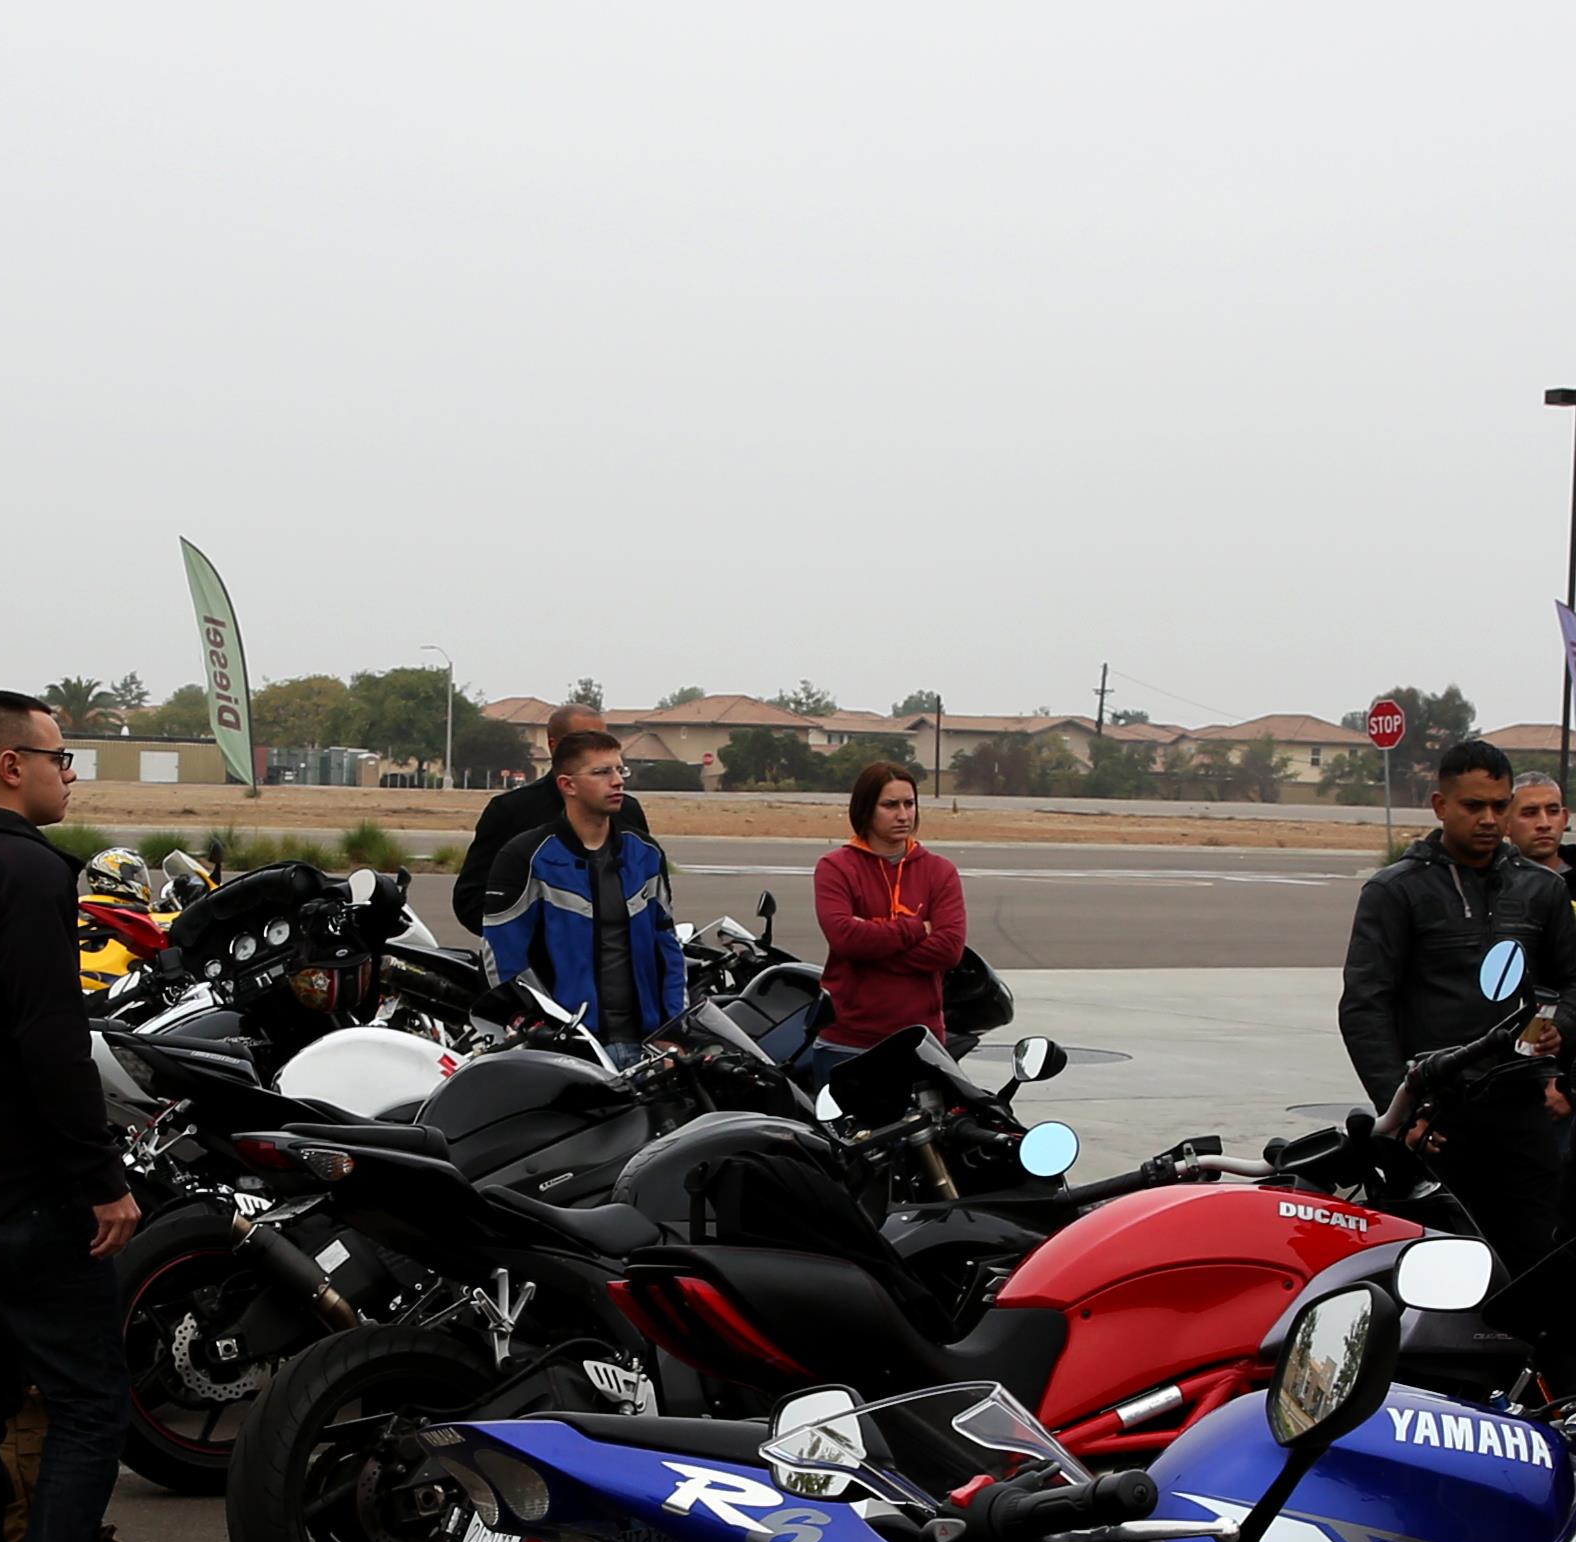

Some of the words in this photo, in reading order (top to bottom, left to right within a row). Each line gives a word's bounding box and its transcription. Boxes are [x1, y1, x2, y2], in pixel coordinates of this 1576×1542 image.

[1369, 714, 1402, 735] STOP
[1279, 1201, 1368, 1232] DUCATI
[1386, 1407, 1553, 1469] YAMAHA
